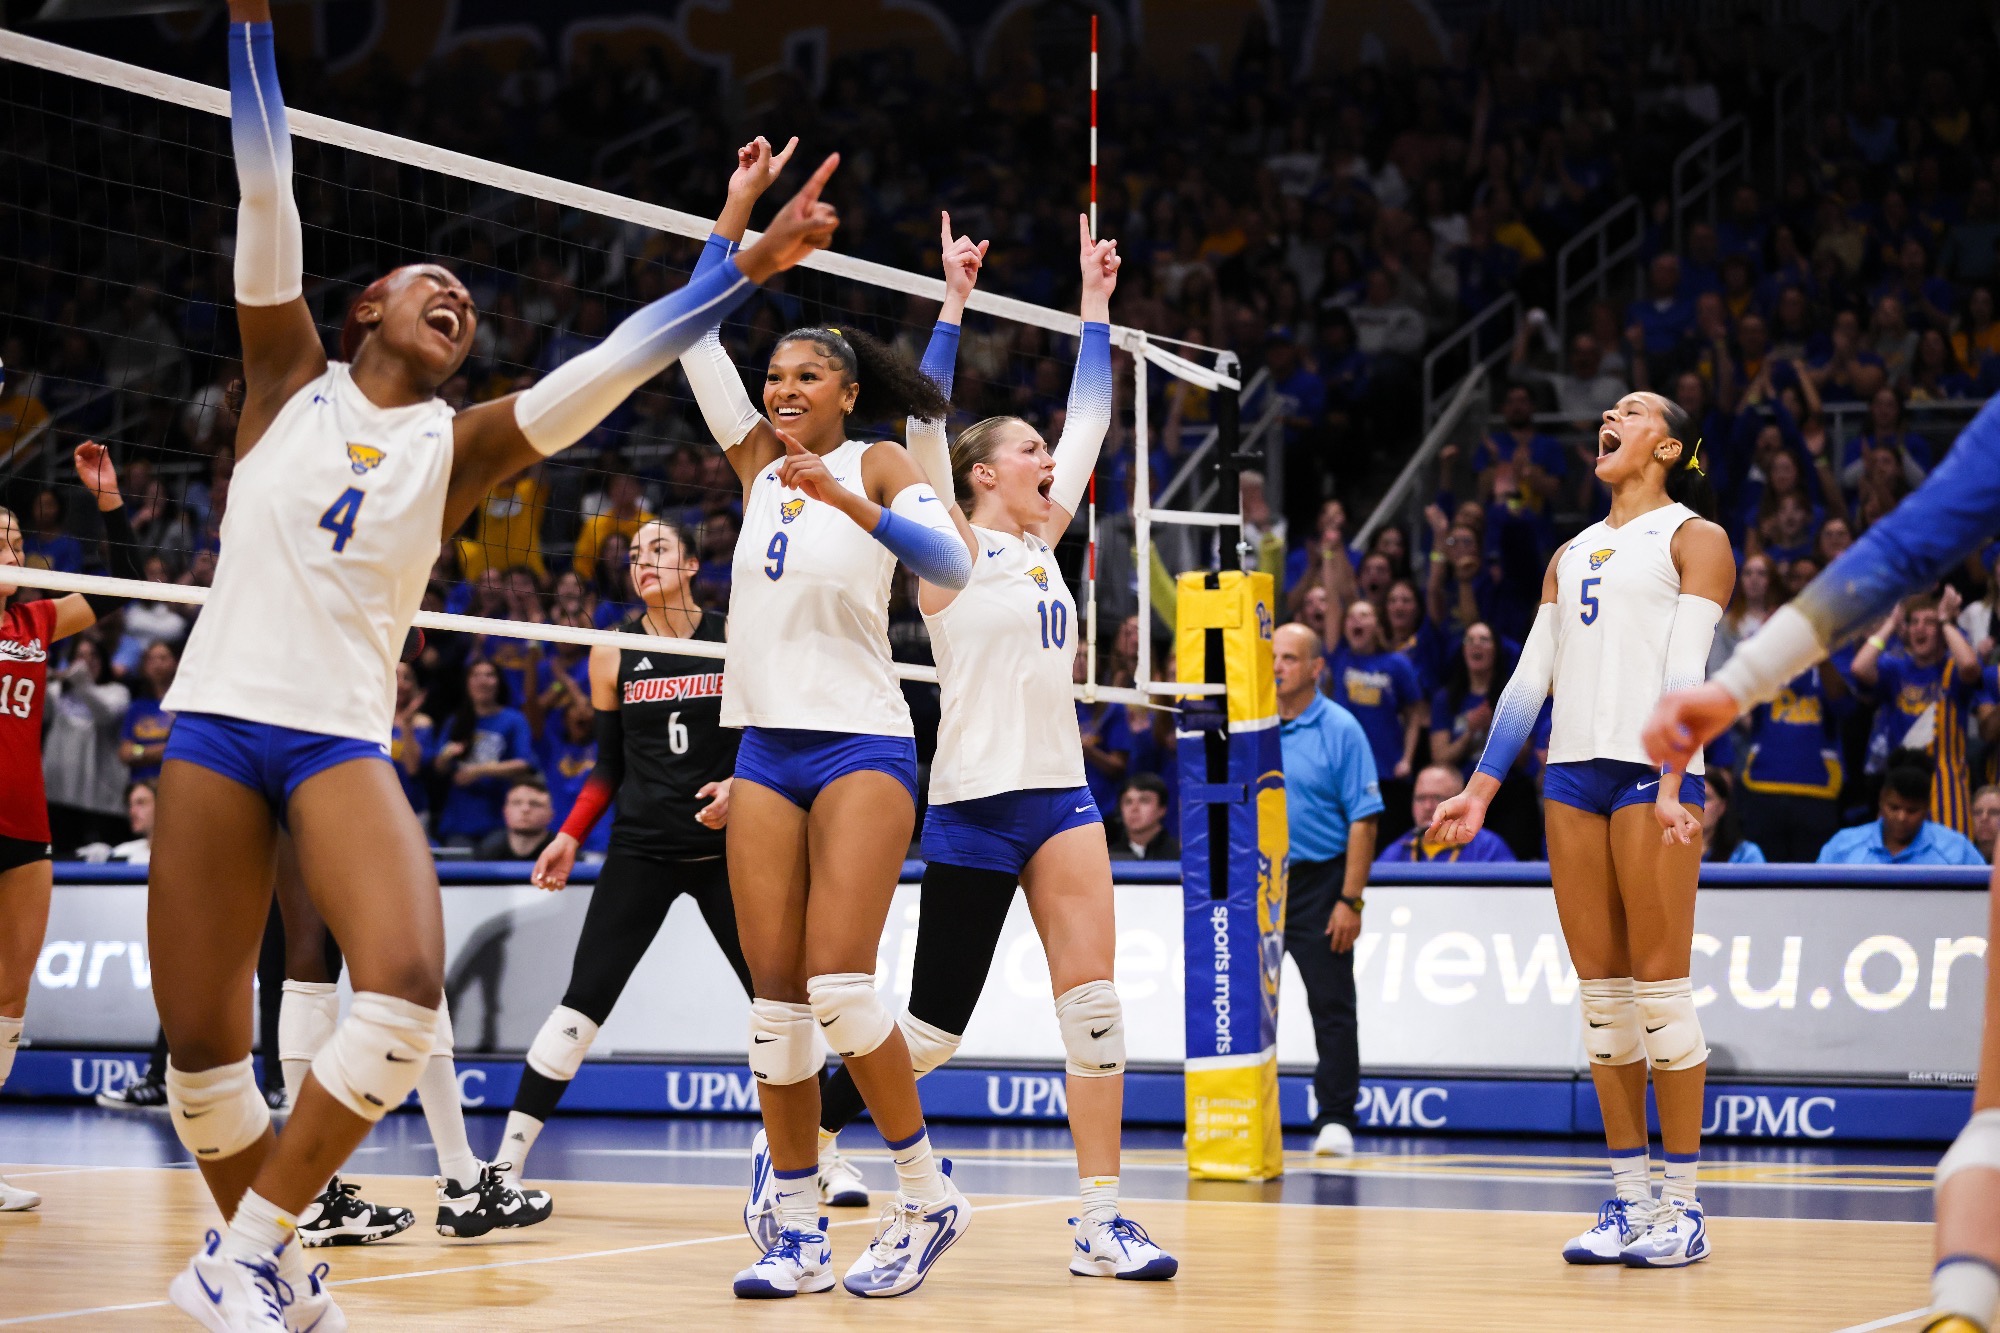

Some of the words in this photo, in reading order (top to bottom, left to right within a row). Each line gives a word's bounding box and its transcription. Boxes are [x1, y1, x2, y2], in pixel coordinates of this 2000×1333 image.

[317, 486, 367, 554] 4
[764, 531, 789, 582] 9
[1037, 599, 1067, 650] 10
[1580, 577, 1602, 626] 5
[0, 674, 36, 719] 19
[623, 673, 725, 704] LOUISVILLE
[668, 711, 689, 754] 6
[1210, 906, 1231, 972] sports
[1212, 974, 1233, 1054] imports
[666, 1071, 761, 1111] UPM
[987, 1075, 1068, 1116] UPM
[904, 1202, 919, 1211] NIKE
